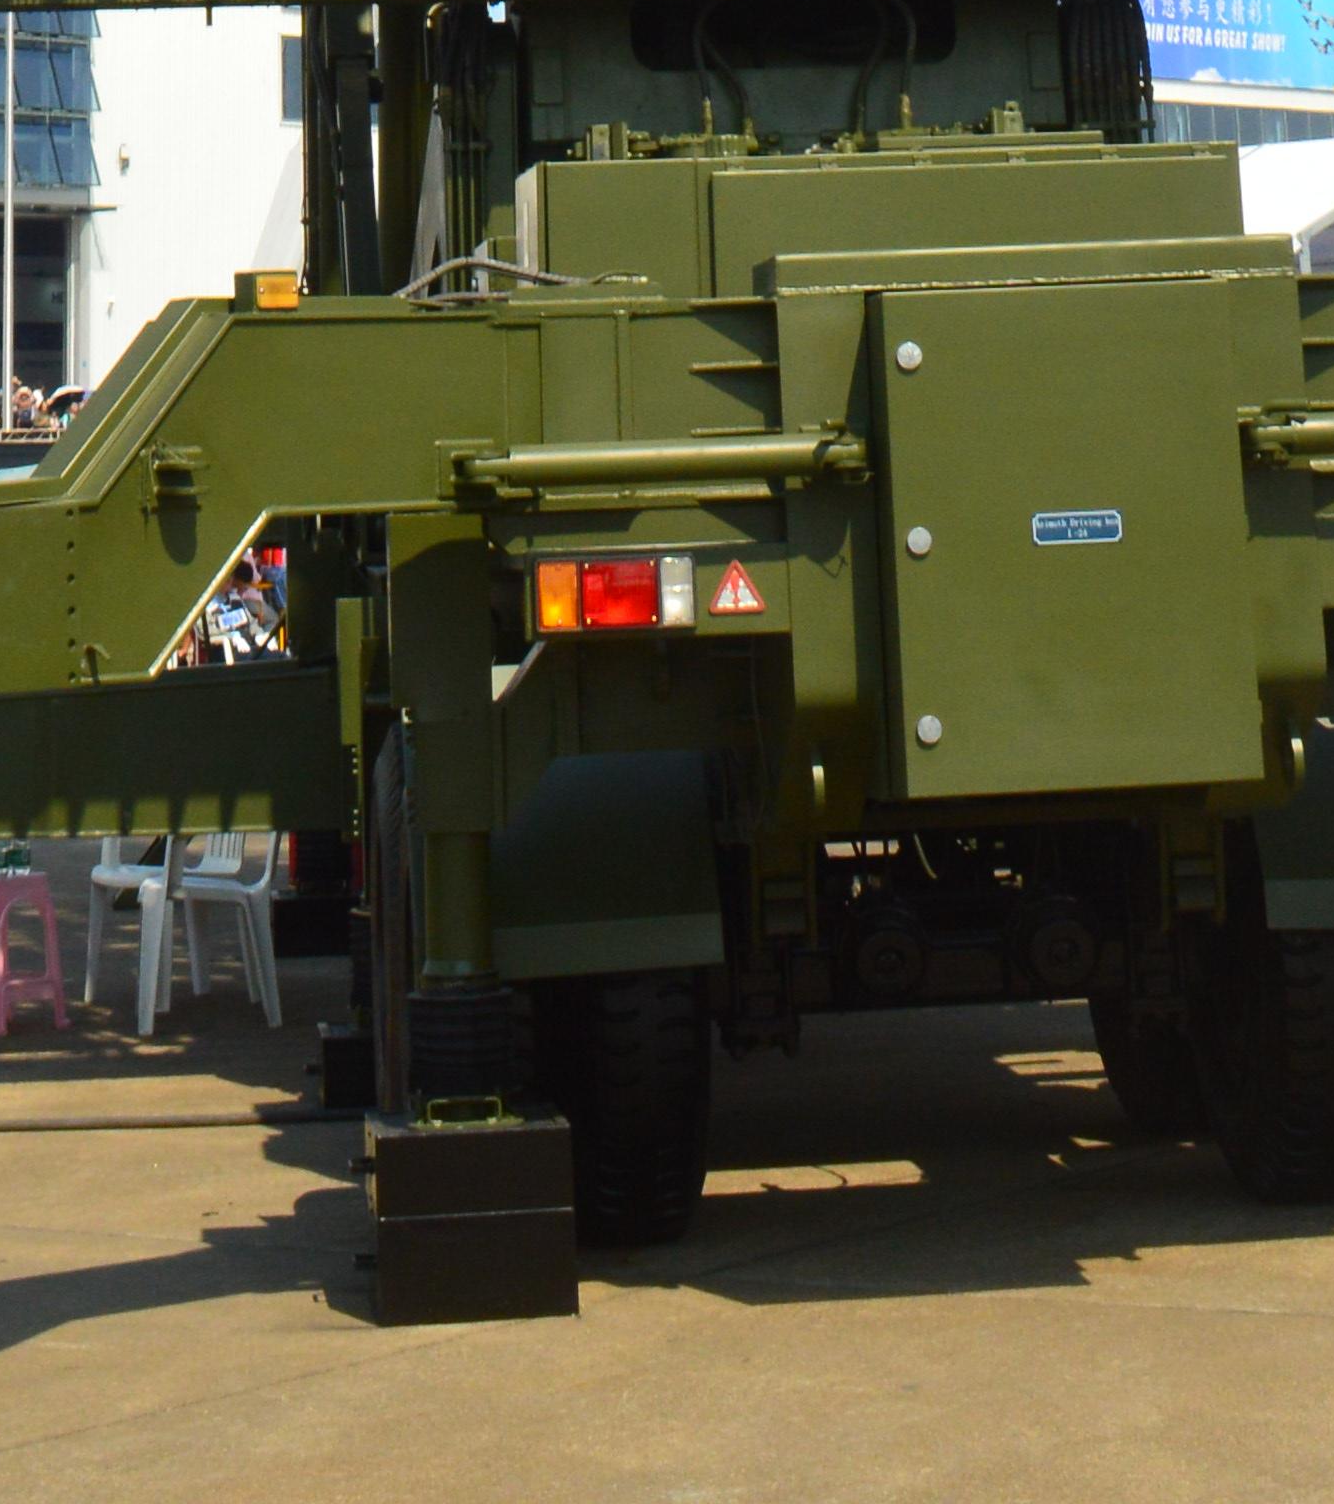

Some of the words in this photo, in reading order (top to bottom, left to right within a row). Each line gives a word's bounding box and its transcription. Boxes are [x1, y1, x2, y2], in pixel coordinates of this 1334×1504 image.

[1167, 23, 1181, 45] US
[1182, 25, 1203, 47] FOR
[1204, 27, 1213, 47] A
[1214, 28, 1248, 50] GREAT
[1252, 31, 1286, 53] SHOW!
